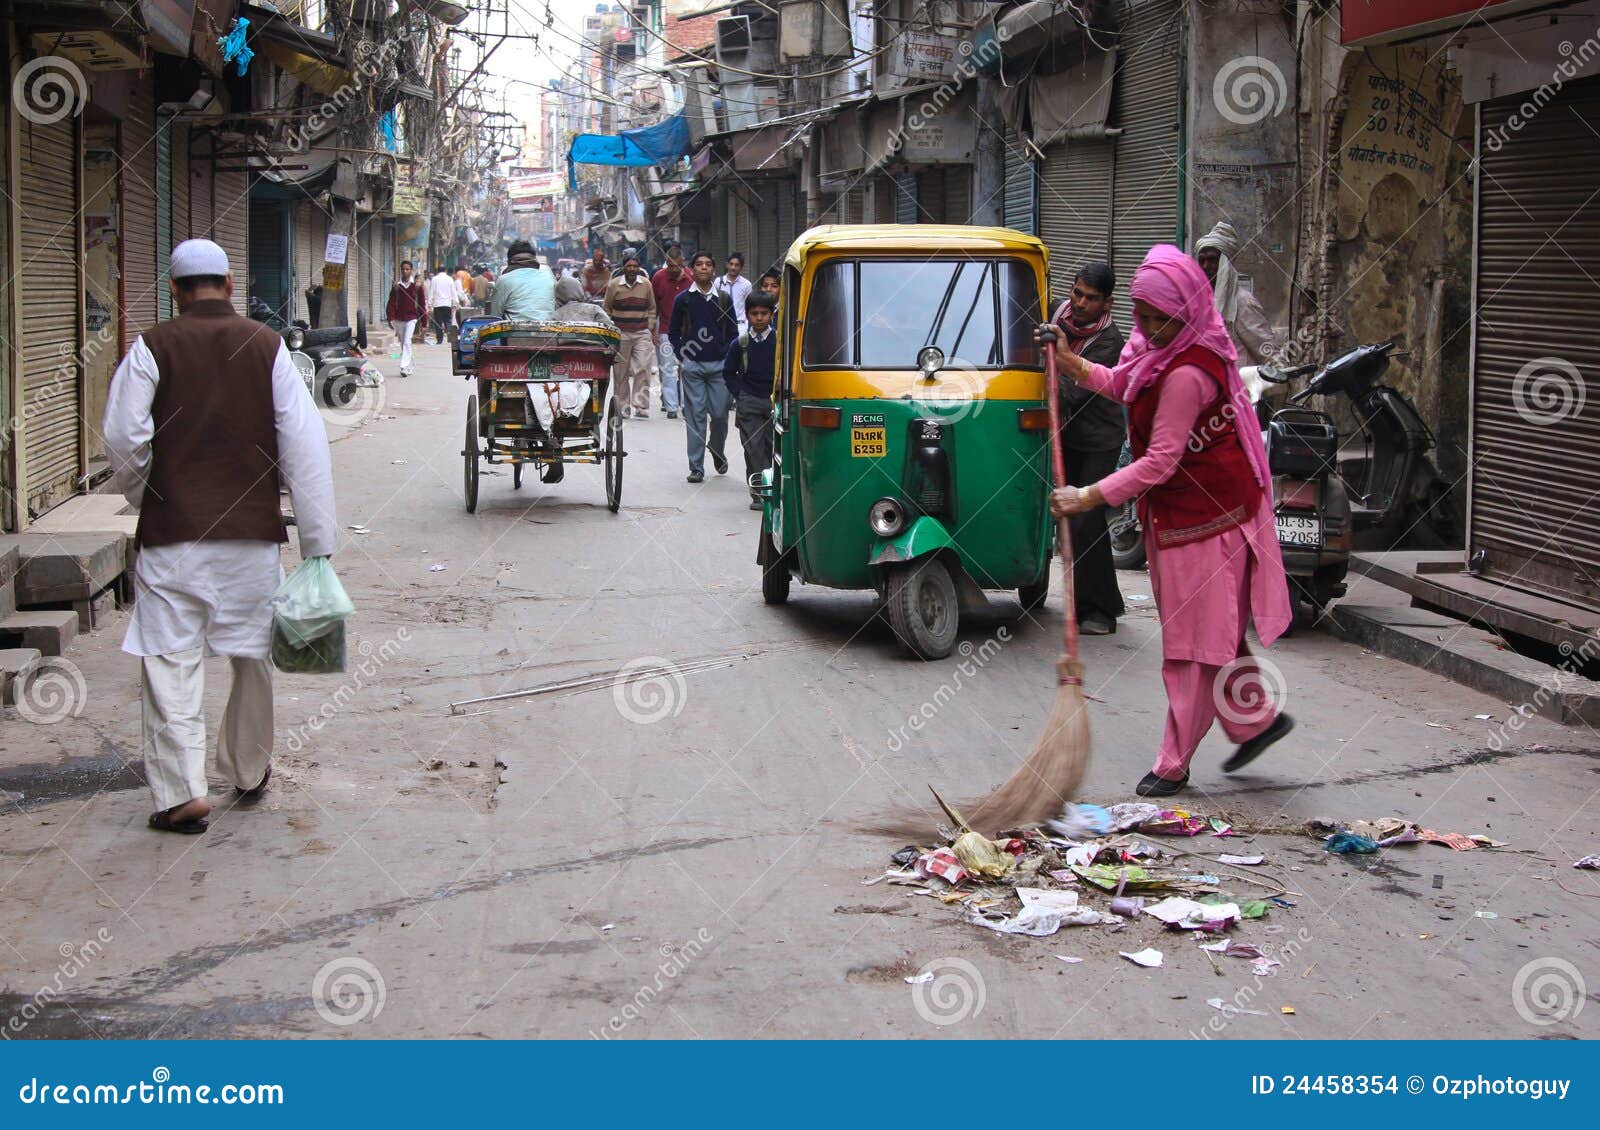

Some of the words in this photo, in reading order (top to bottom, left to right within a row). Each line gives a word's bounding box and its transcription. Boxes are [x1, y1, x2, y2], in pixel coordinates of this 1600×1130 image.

[1372, 96, 1390, 111] 20
[1366, 115, 1388, 132] 30
[1416, 132, 1432, 152] 36
[1216, 164, 1250, 173] HOSPITAL
[854, 430, 883, 441] DL1RK
[854, 444, 883, 454] 6259
